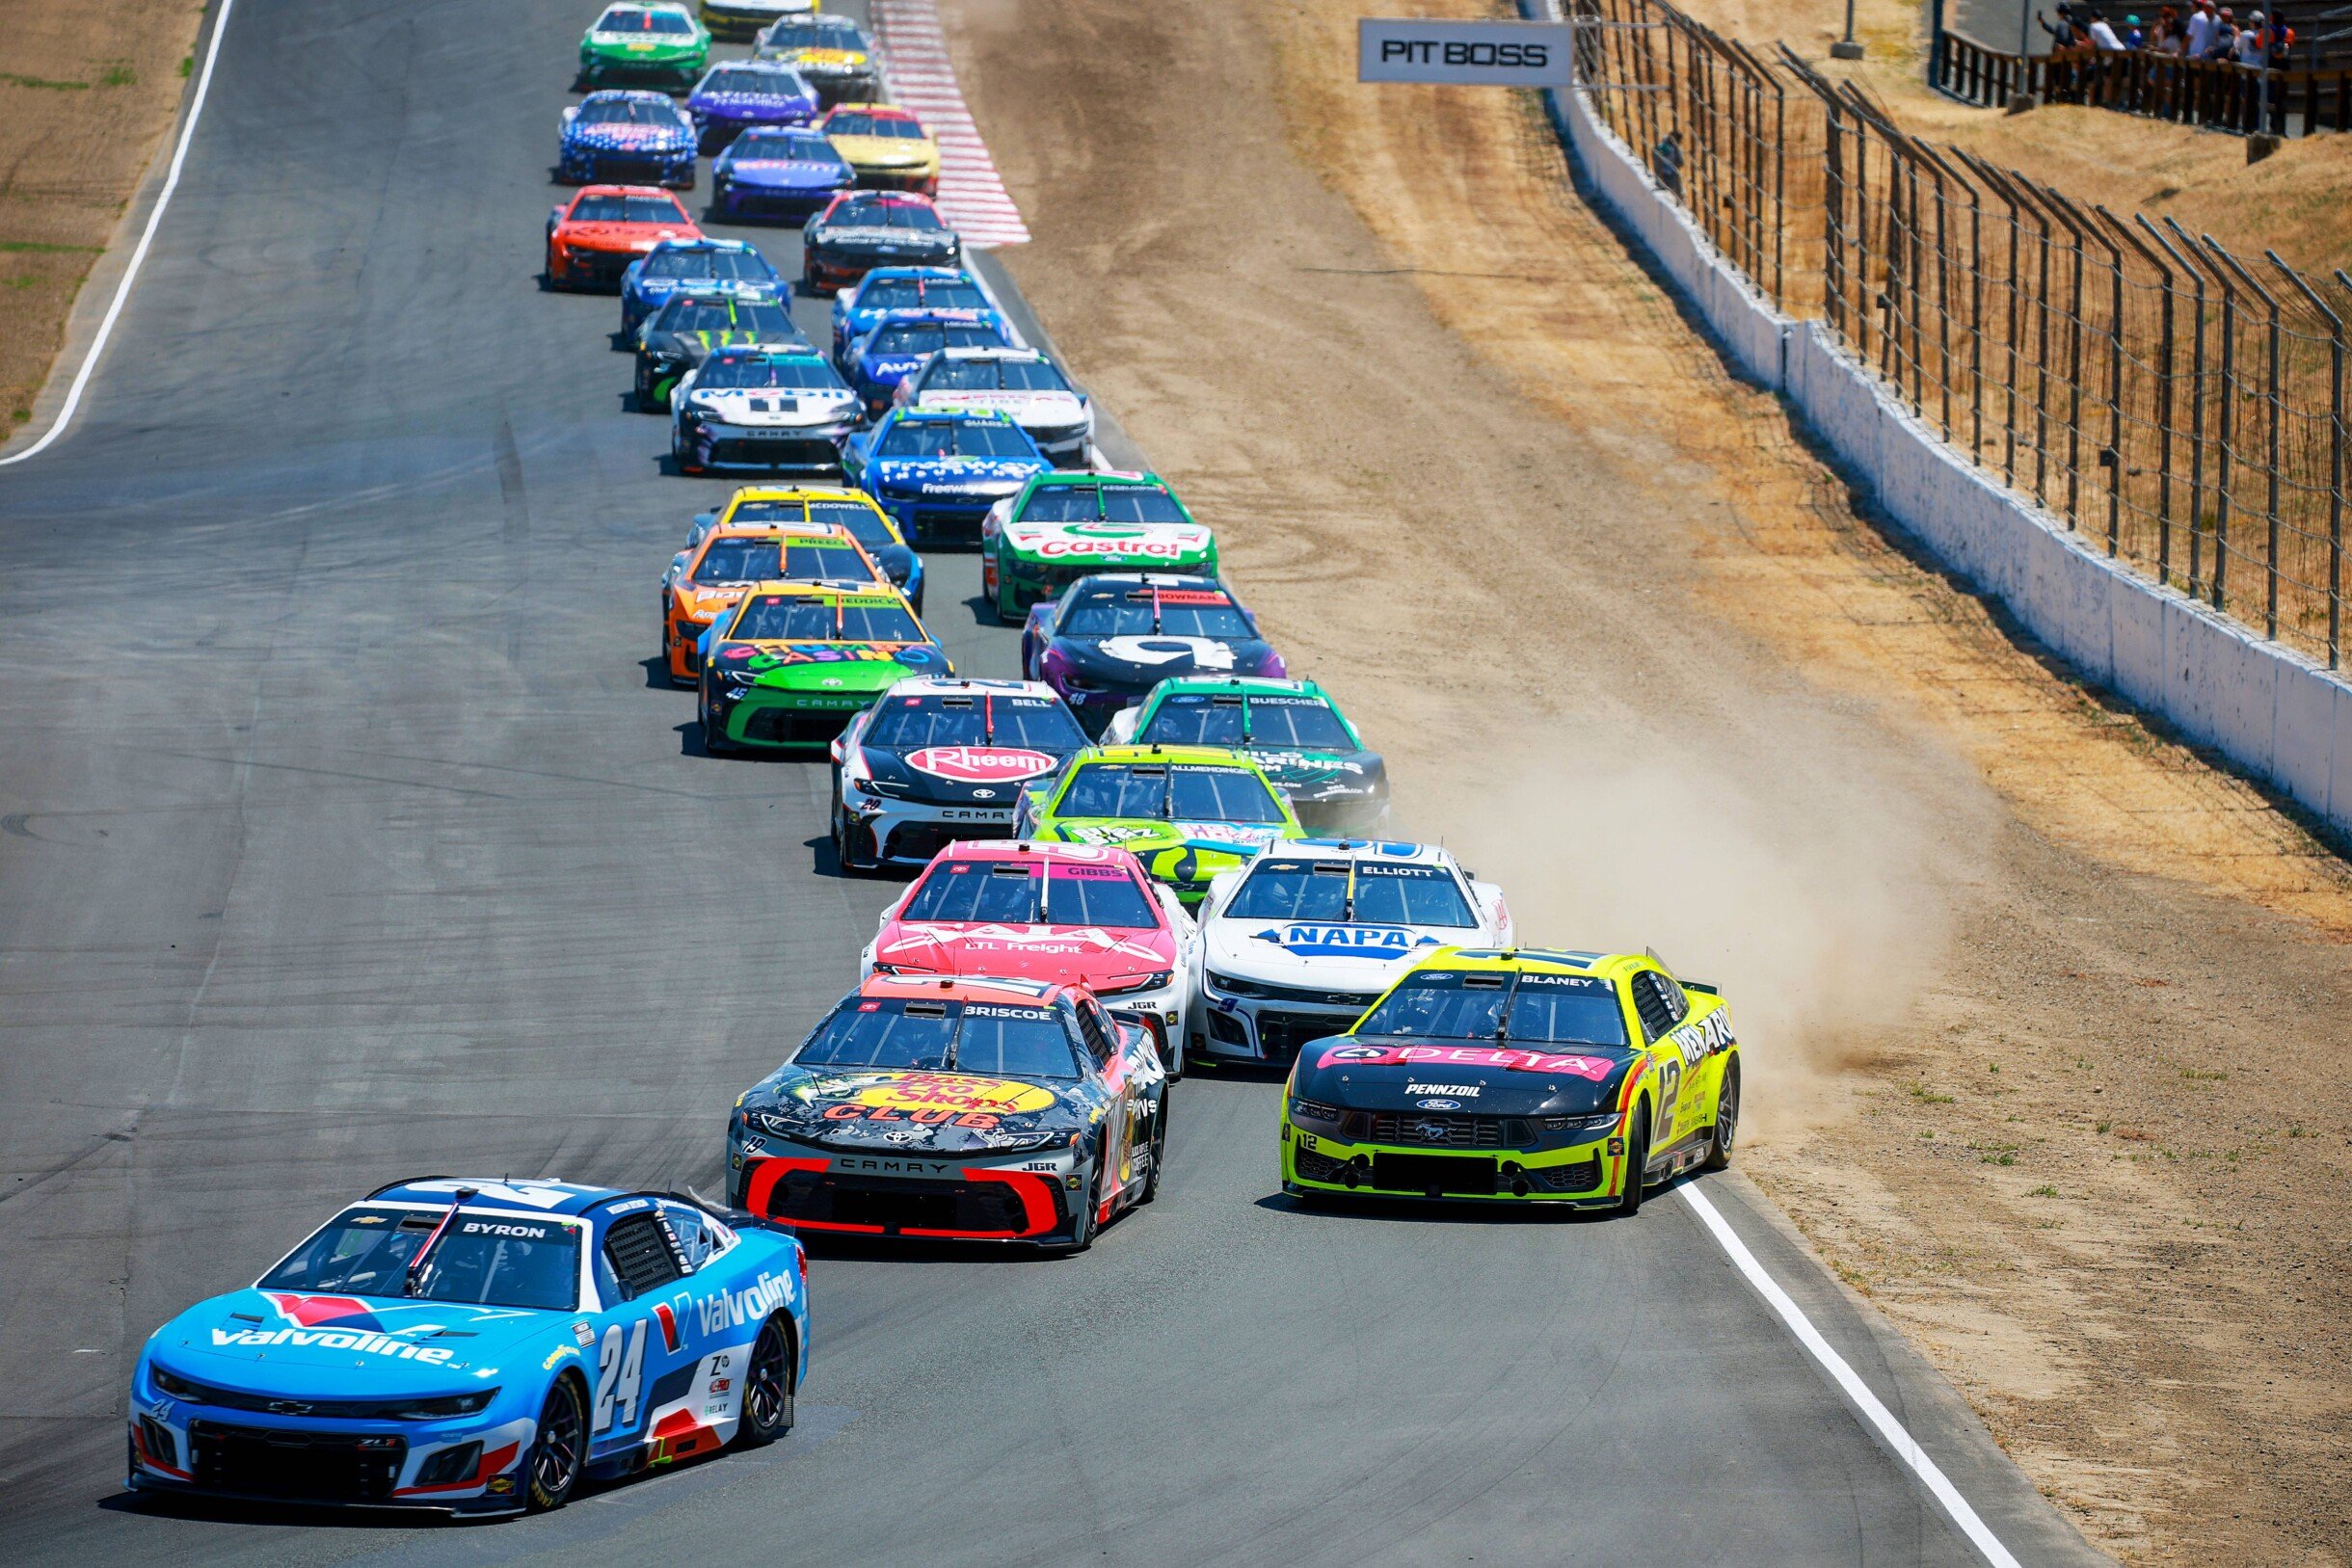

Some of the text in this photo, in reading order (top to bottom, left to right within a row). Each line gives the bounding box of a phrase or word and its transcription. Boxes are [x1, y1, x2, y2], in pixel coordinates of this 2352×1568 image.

[1381, 40, 1548, 67] PIT BOSS
[922, 483, 981, 494] Freeway
[1042, 541, 1179, 557] Castrol
[748, 651, 930, 669] CASINO
[726, 687, 749, 700] 45
[1069, 693, 1086, 704] 48
[796, 699, 871, 708] CAMRY
[1012, 699, 1052, 707] BELL
[1250, 697, 1323, 706] BUESCHER
[922, 747, 1047, 773] Rheem
[862, 798, 882, 811] 20
[1068, 866, 1124, 878] GIBBS
[1362, 866, 1433, 878] ELLIOTT
[1289, 927, 1409, 947] NAPA
[965, 942, 1083, 955] LTL Freight
[1522, 974, 1593, 988] BLANEY
[1127, 1001, 1158, 1010] JGR
[964, 1006, 1052, 1021] BRISCOE
[1669, 1003, 1733, 1066] MENAR
[1397, 1047, 1591, 1071] DELTA
[895, 1080, 975, 1095] Pro
[898, 1073, 1005, 1087] Bass
[1404, 1083, 1481, 1097] PENNZOIL
[886, 1089, 1021, 1113] Shops
[1652, 1057, 1680, 1147] 12
[822, 1103, 1001, 1129] CLUB
[741, 1135, 767, 1155] 19
[1303, 1133, 1318, 1152] 12
[841, 1158, 949, 1173] CAMRY
[1022, 1162, 1057, 1172] JGR
[463, 1222, 547, 1238] BYRON
[697, 1268, 795, 1337] Valvoline
[212, 1325, 455, 1366] Valvoline
[593, 1318, 648, 1435] 24
[150, 1398, 175, 1422] 24
[708, 1403, 728, 1414] RELAY
